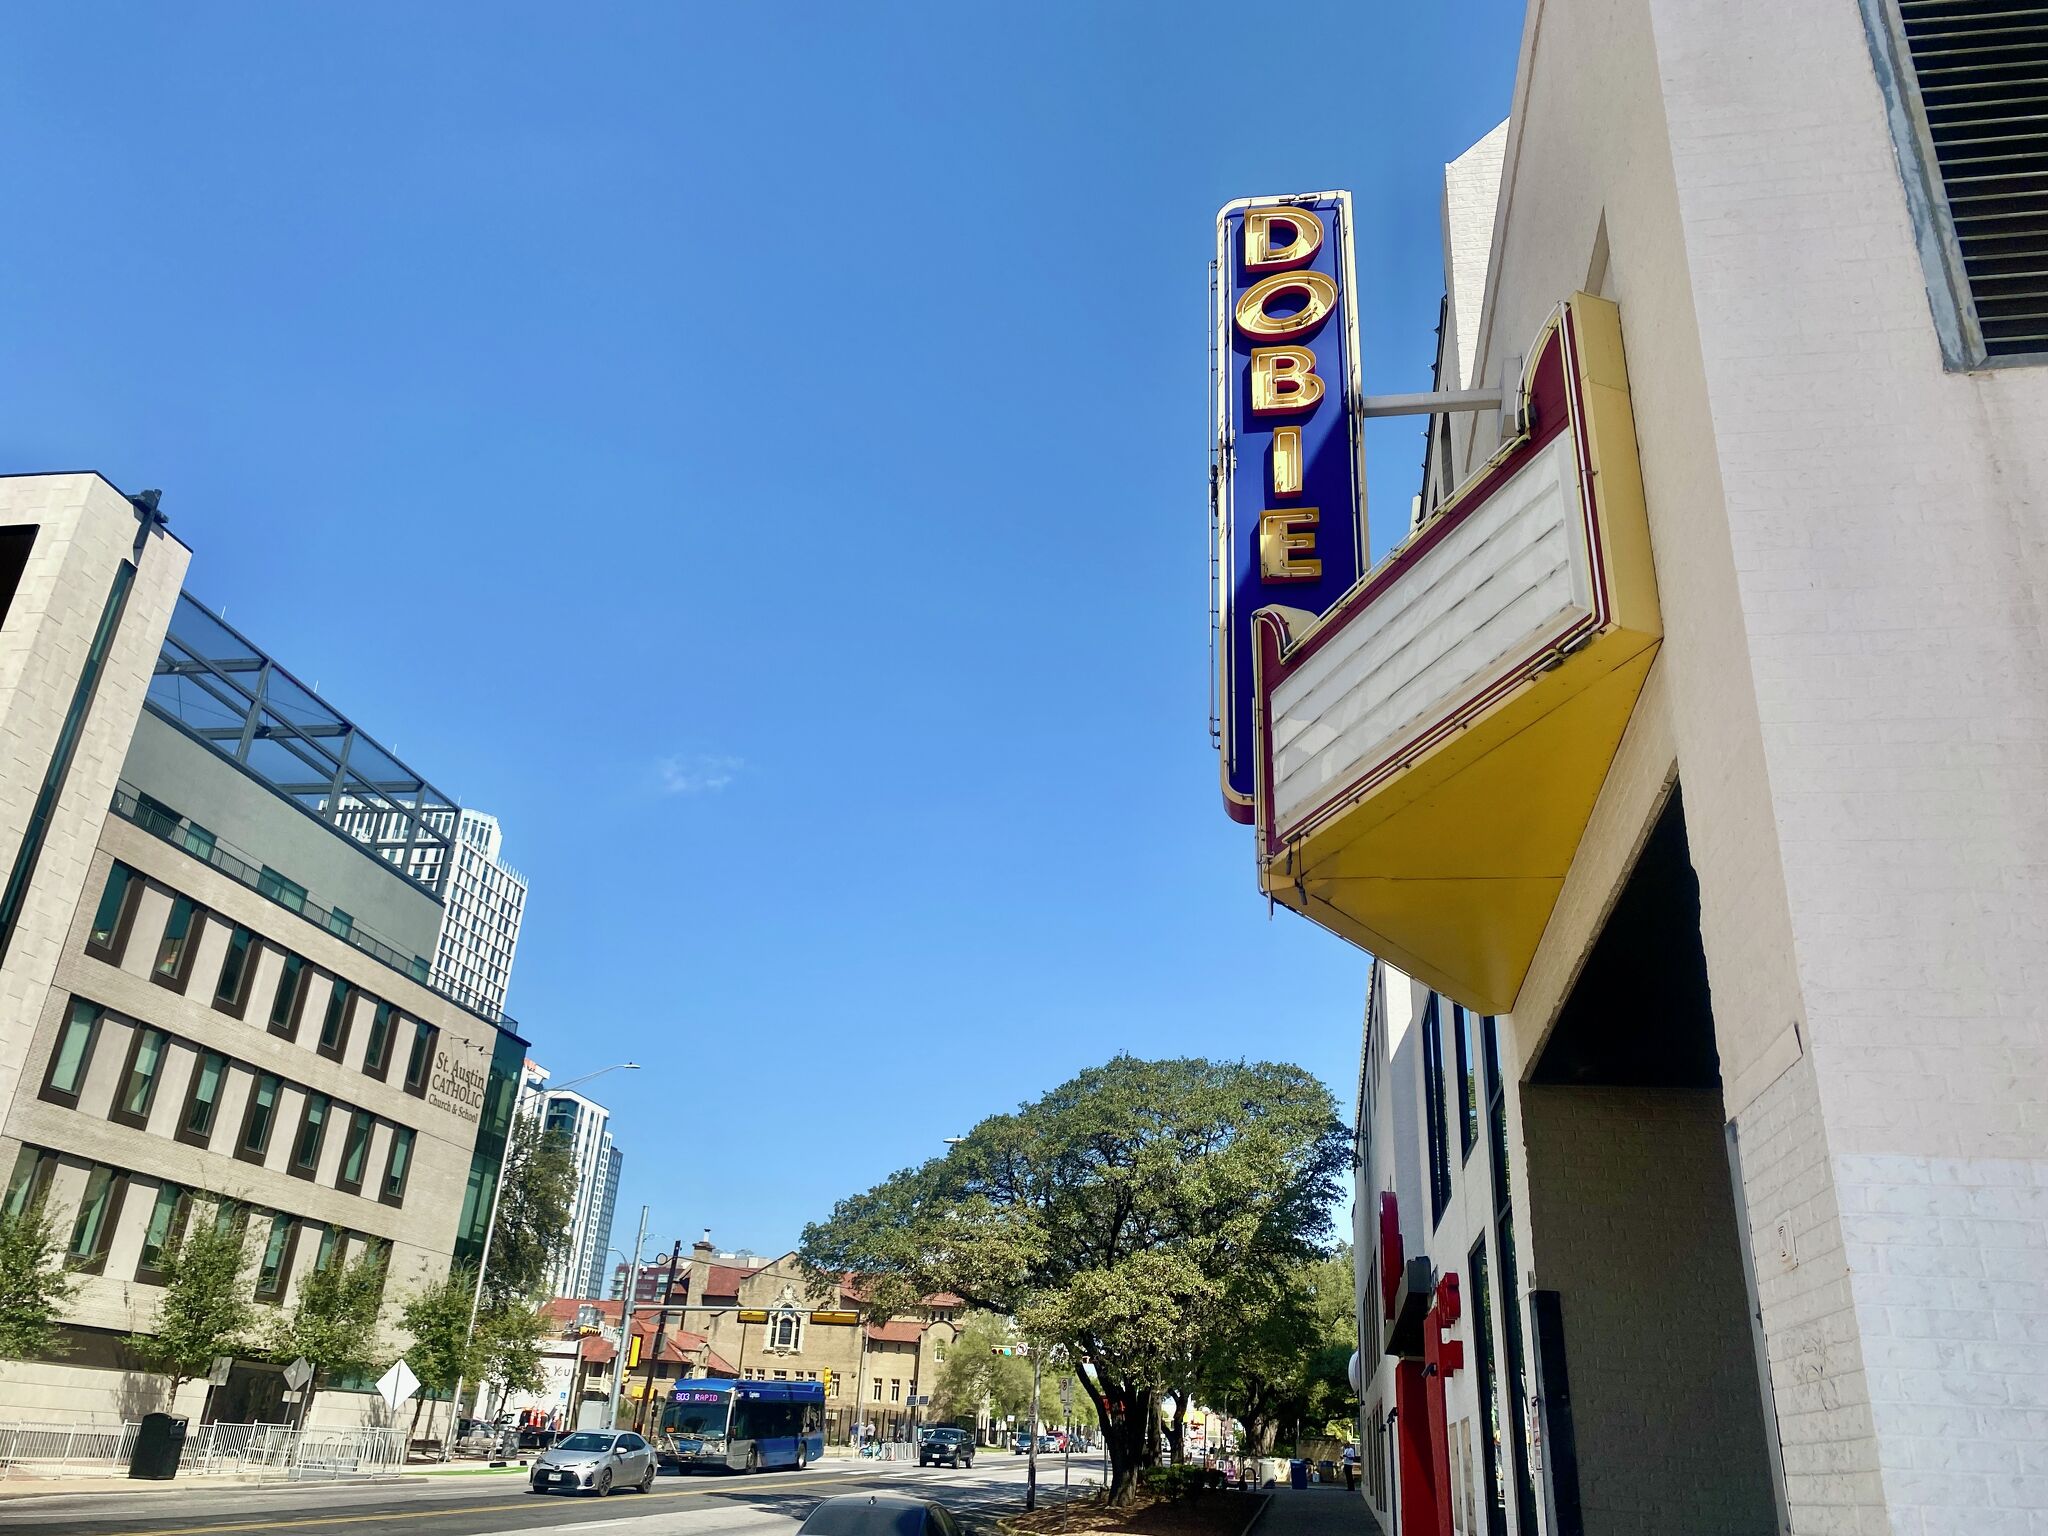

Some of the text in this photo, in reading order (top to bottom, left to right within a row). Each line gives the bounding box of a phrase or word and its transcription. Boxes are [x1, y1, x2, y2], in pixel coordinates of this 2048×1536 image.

[1235, 206, 1338, 584] DOBIE
[436, 1051, 485, 1089] St. Austin
[428, 1093, 479, 1124] Church & School
[432, 1074, 483, 1109] CATHOLIC
[694, 1393, 718, 1402] RAPID
